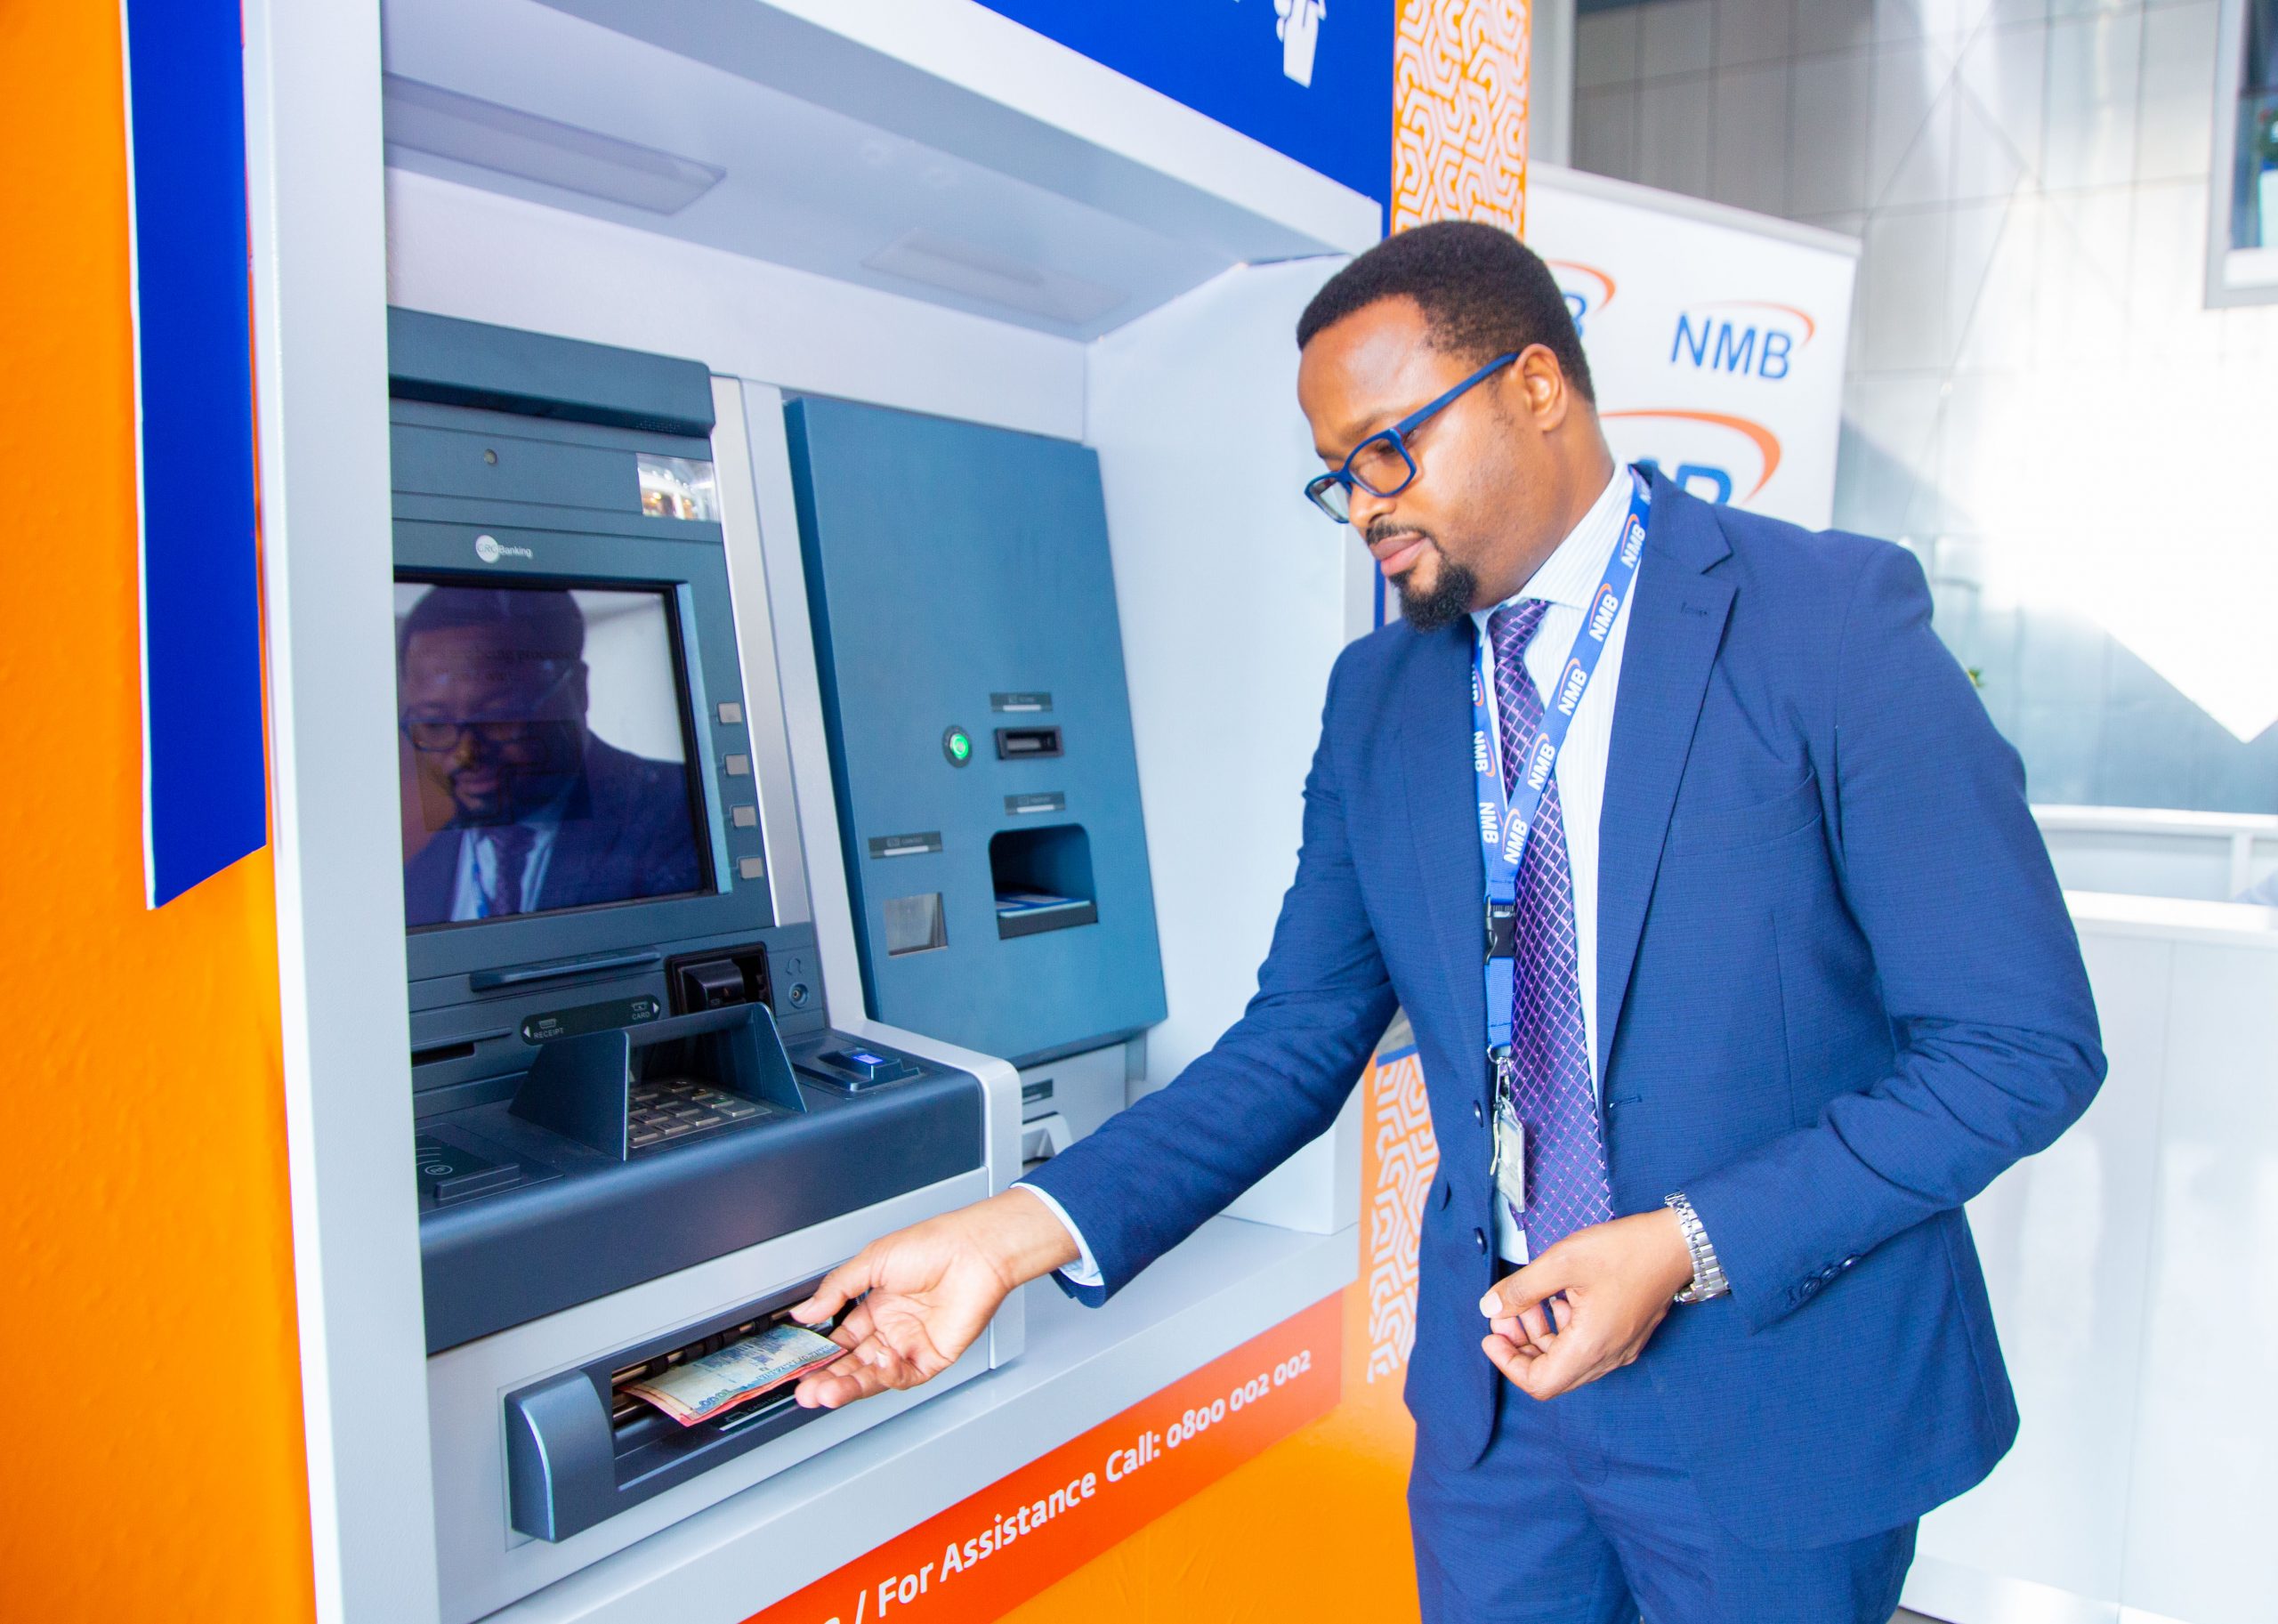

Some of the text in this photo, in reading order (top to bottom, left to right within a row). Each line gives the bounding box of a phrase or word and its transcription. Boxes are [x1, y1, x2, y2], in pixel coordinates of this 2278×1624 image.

[1670, 311, 1793, 380] NMB
[498, 544, 533, 559] Banking
[1620, 523, 1646, 570] NMB
[1589, 594, 1618, 642] NMB
[1557, 667, 1587, 716] NMB
[1474, 730, 1489, 772] NMB
[1527, 742, 1555, 791] NMB
[1479, 802, 1499, 844] NMB
[1504, 818, 1528, 865] NMB
[533, 1027, 564, 1039] RECEIPT
[632, 1012, 650, 1020] CARD
[877, 1562, 934, 1618] For
[940, 1472, 1096, 1583] Assistance
[1105, 1430, 1160, 1483] Call:
[1166, 1398, 1225, 1450] 0800
[1230, 1373, 1270, 1411] 002
[1273, 1350, 1312, 1386] 002
